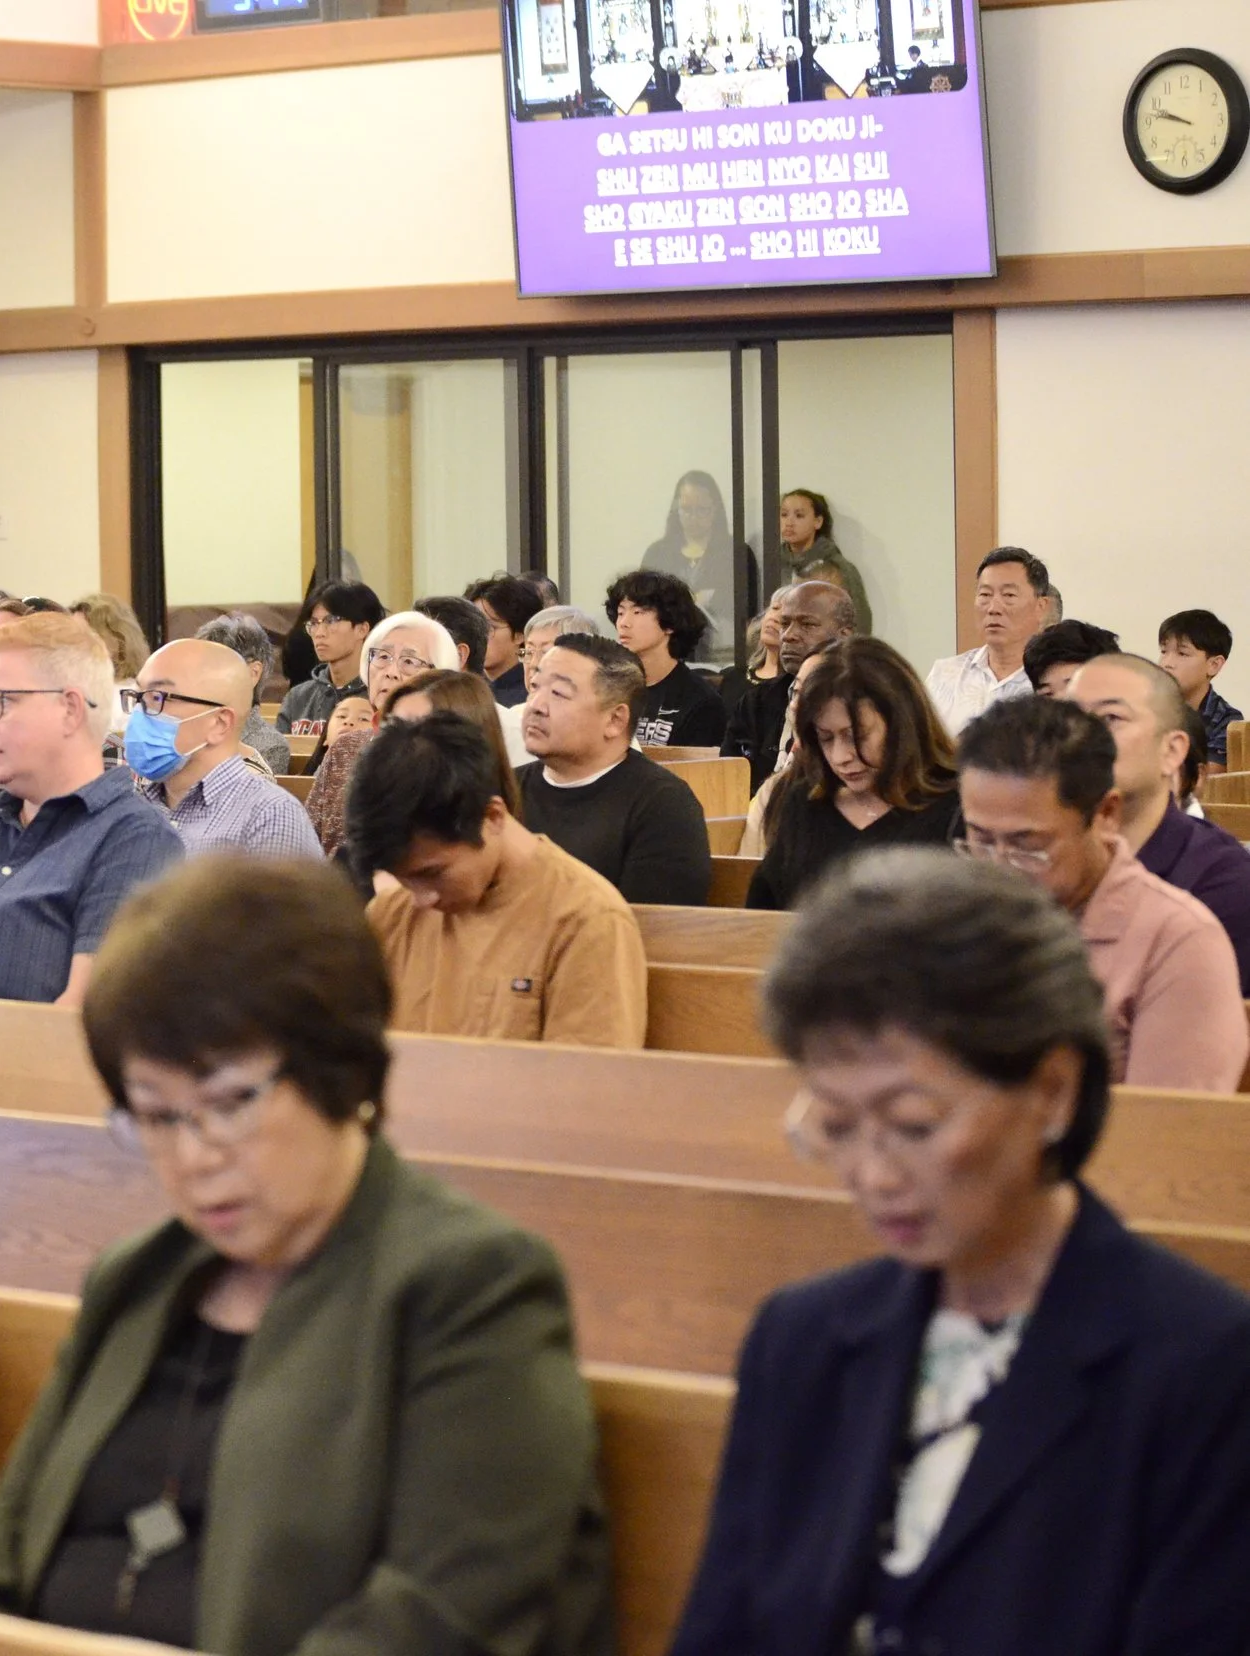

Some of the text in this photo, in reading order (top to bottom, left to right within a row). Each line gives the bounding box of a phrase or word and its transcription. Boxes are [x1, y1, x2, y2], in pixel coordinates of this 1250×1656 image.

[1164, 81, 1172, 95] 11
[1180, 75, 1190, 89] 12
[1152, 97, 1161, 111] 10
[1211, 93, 1218, 107] 2
[1145, 114, 1152, 130] 9
[1217, 113, 1224, 127] 3
[597, 115, 883, 156] GA SETSU HI SON KU DOKU JI-
[1151, 136, 1158, 149] 8
[1210, 135, 1217, 148] 4
[1181, 154, 1188, 168] 6
[597, 151, 889, 196] SHU ZEN MU HEN NYO KAI SUI
[584, 204, 626, 233] SHO
[696, 197, 736, 227] ZEN
[789, 192, 834, 221] SHO
[836, 190, 863, 219] JO
[865, 187, 909, 217] SHA
[615, 239, 628, 266] E
[630, 238, 654, 265] SE
[656, 235, 698, 264] SHU
[701, 234, 726, 262] JO
[750, 230, 794, 259] SHO
[796, 229, 820, 257] HI
[823, 226, 881, 256] KOKU
